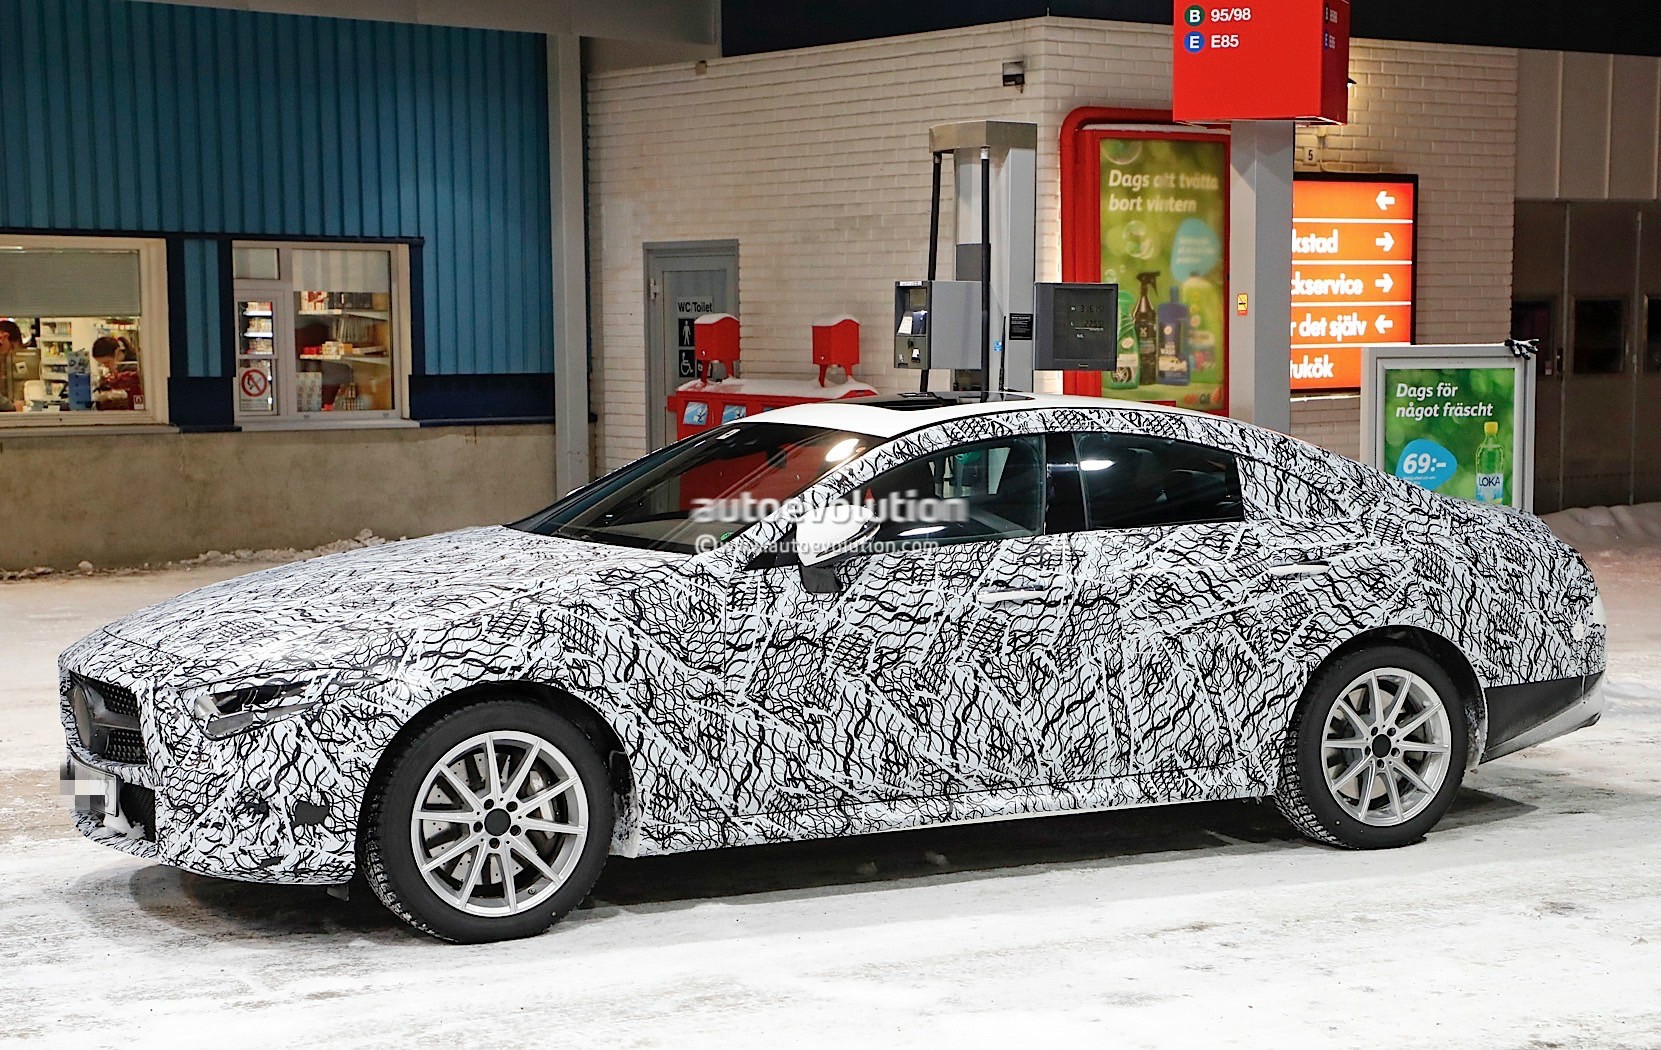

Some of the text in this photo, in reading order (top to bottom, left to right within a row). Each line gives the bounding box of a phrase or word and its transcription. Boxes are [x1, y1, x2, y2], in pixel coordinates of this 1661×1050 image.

[1189, 8, 1252, 23] B 95/98
[1189, 35, 1240, 49] E E85
[1307, 149, 1314, 161] 5
[1108, 169, 1150, 192] Dags
[1108, 193, 1143, 211] bort
[1299, 313, 1328, 337] det
[1329, 313, 1368, 342] själv
[1396, 382, 1458, 401] Dags för
[1395, 402, 1494, 421] något fräscht
[1402, 453, 1447, 475] 69:-
[1478, 476, 1501, 487] LOKA
